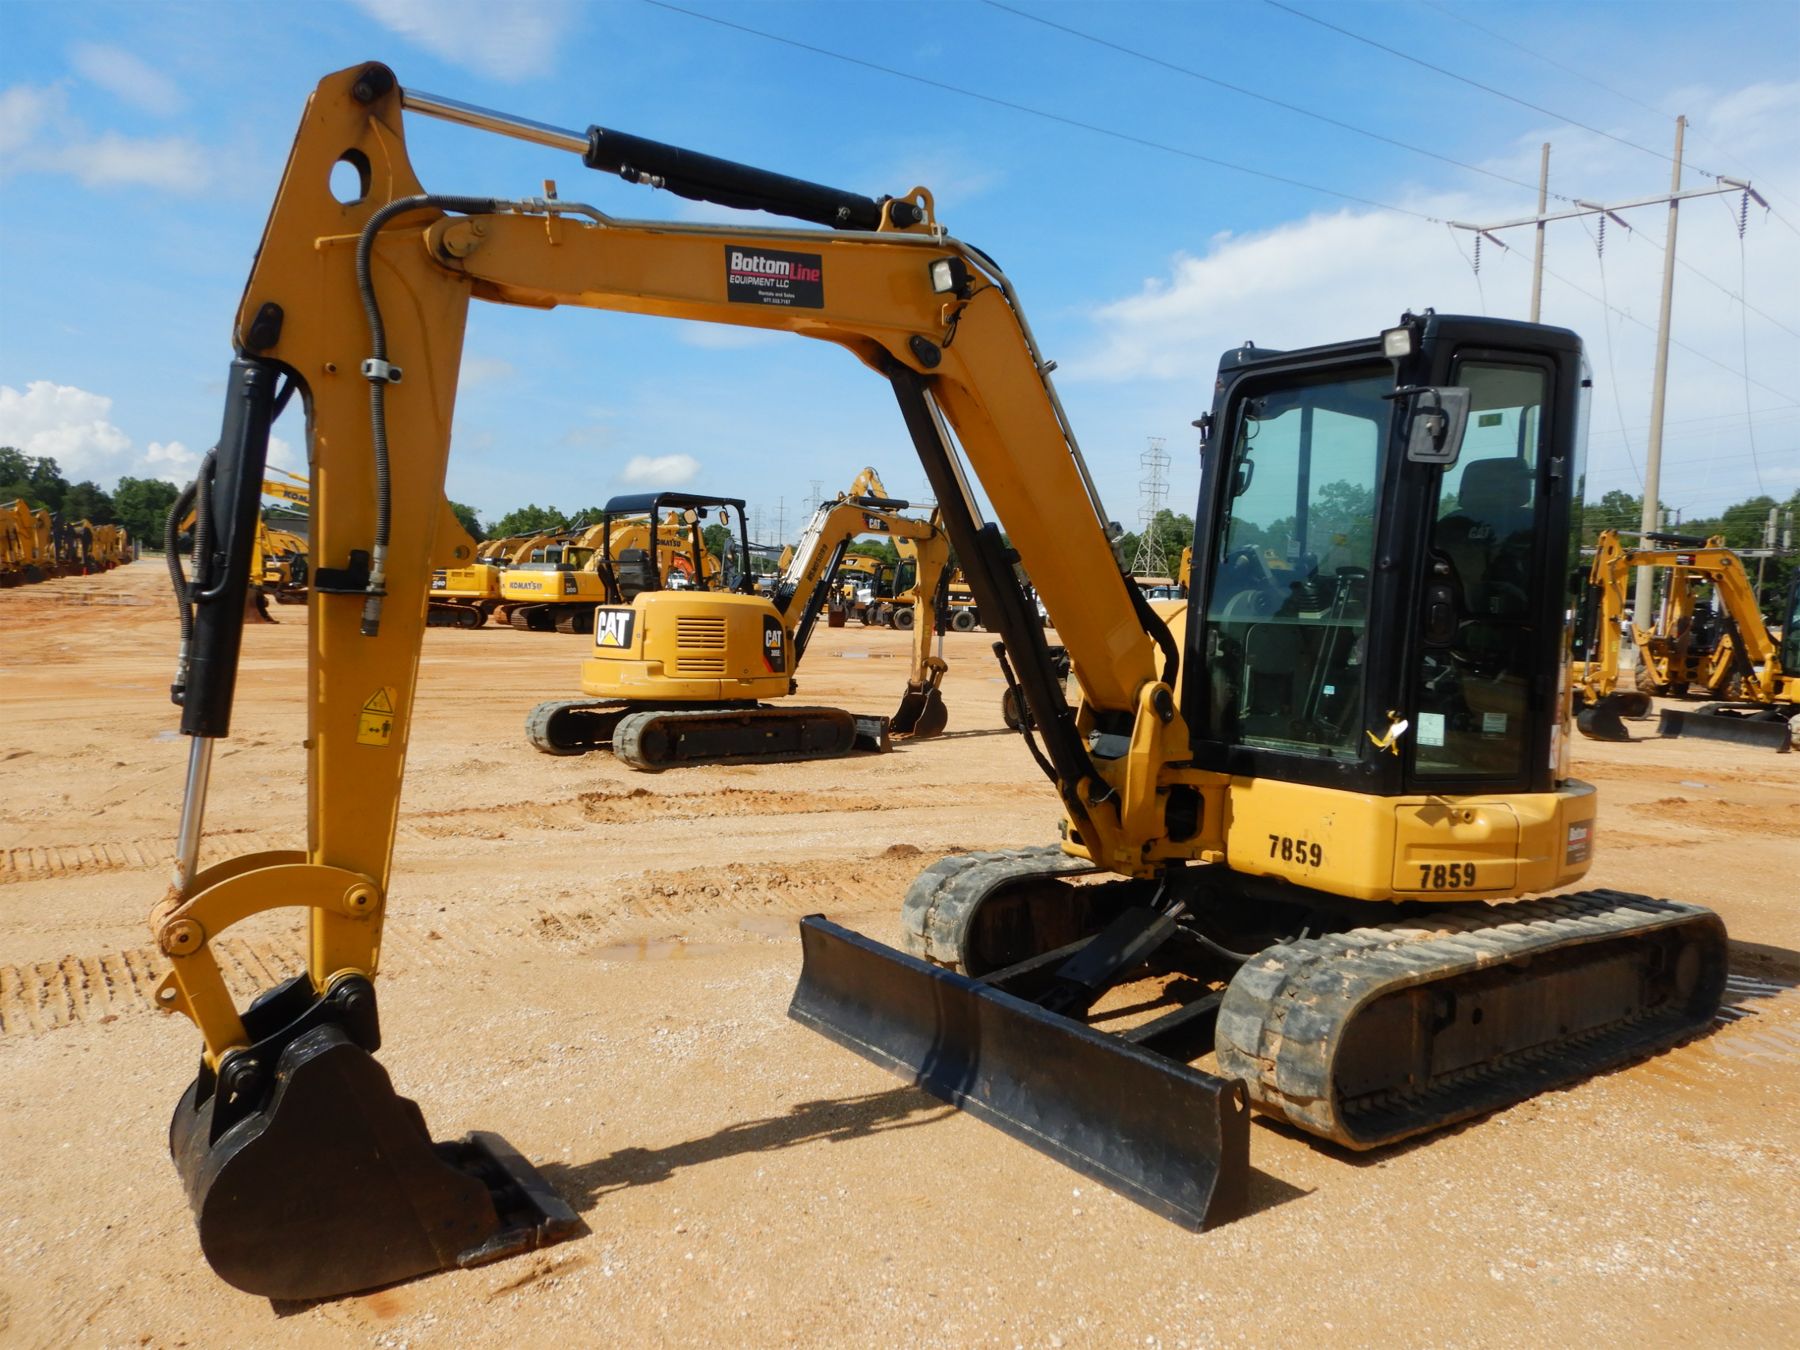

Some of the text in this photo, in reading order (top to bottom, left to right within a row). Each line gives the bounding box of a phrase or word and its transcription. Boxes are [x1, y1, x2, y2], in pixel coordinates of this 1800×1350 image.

[730, 275, 789, 288] EQUIPMENT LLC
[869, 518, 881, 529] CAT
[509, 581, 543, 590] KOMATSU
[597, 611, 630, 647] CAT
[765, 630, 782, 647] CAT
[1269, 834, 1322, 867] 7859
[1419, 863, 1476, 889] 7859
